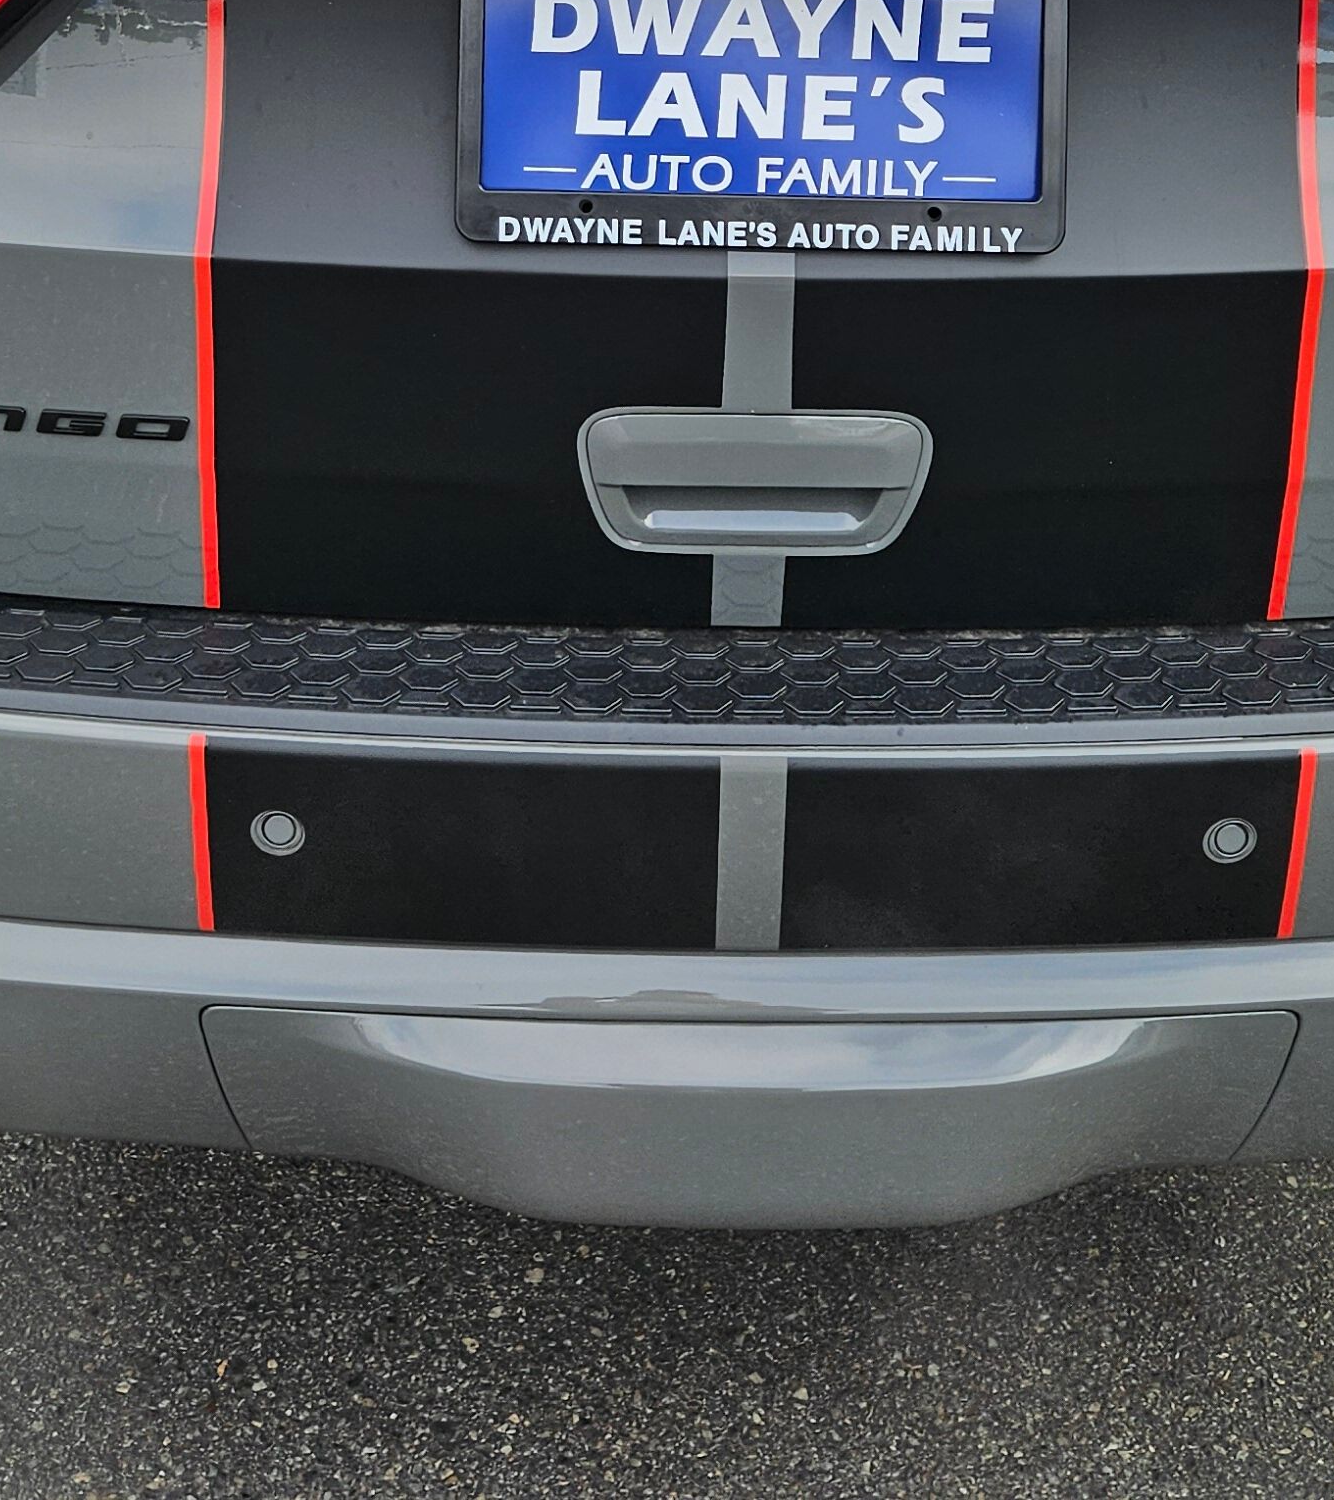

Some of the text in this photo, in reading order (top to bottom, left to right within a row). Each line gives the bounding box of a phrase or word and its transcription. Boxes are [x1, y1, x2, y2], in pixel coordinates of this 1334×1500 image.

[573, 70, 946, 144] LANE'S
[581, 154, 939, 197] AUTO FAMILY
[497, 216, 1024, 254] DWAYNE LANE'S AUTO FAMILY
